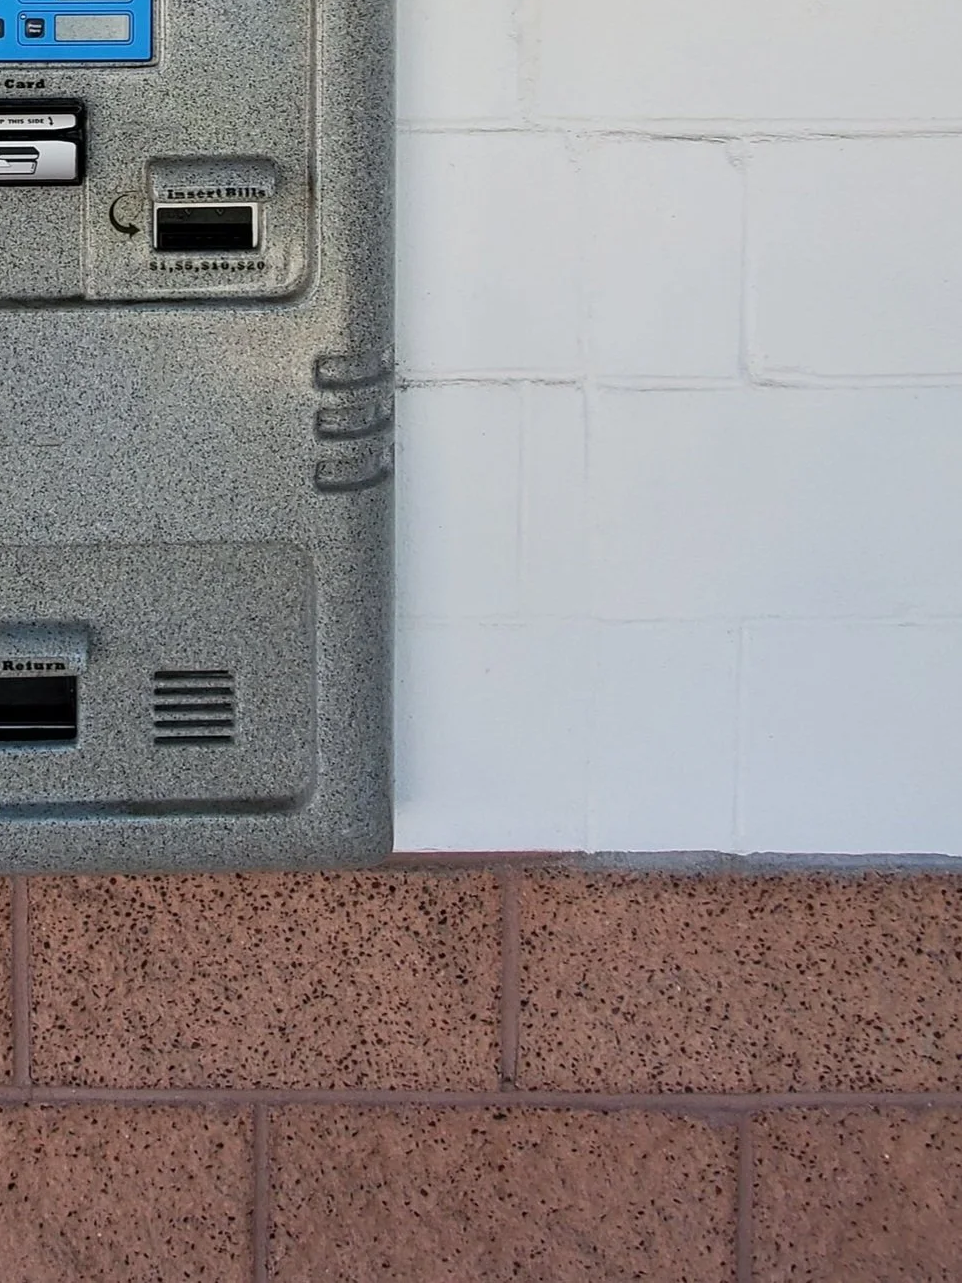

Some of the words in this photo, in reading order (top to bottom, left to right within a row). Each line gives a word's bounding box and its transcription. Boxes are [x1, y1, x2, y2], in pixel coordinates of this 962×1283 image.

[4, 79, 45, 89] Card
[167, 188, 223, 199] Insert
[225, 187, 266, 197] Bills
[2, 660, 66, 671] Return
